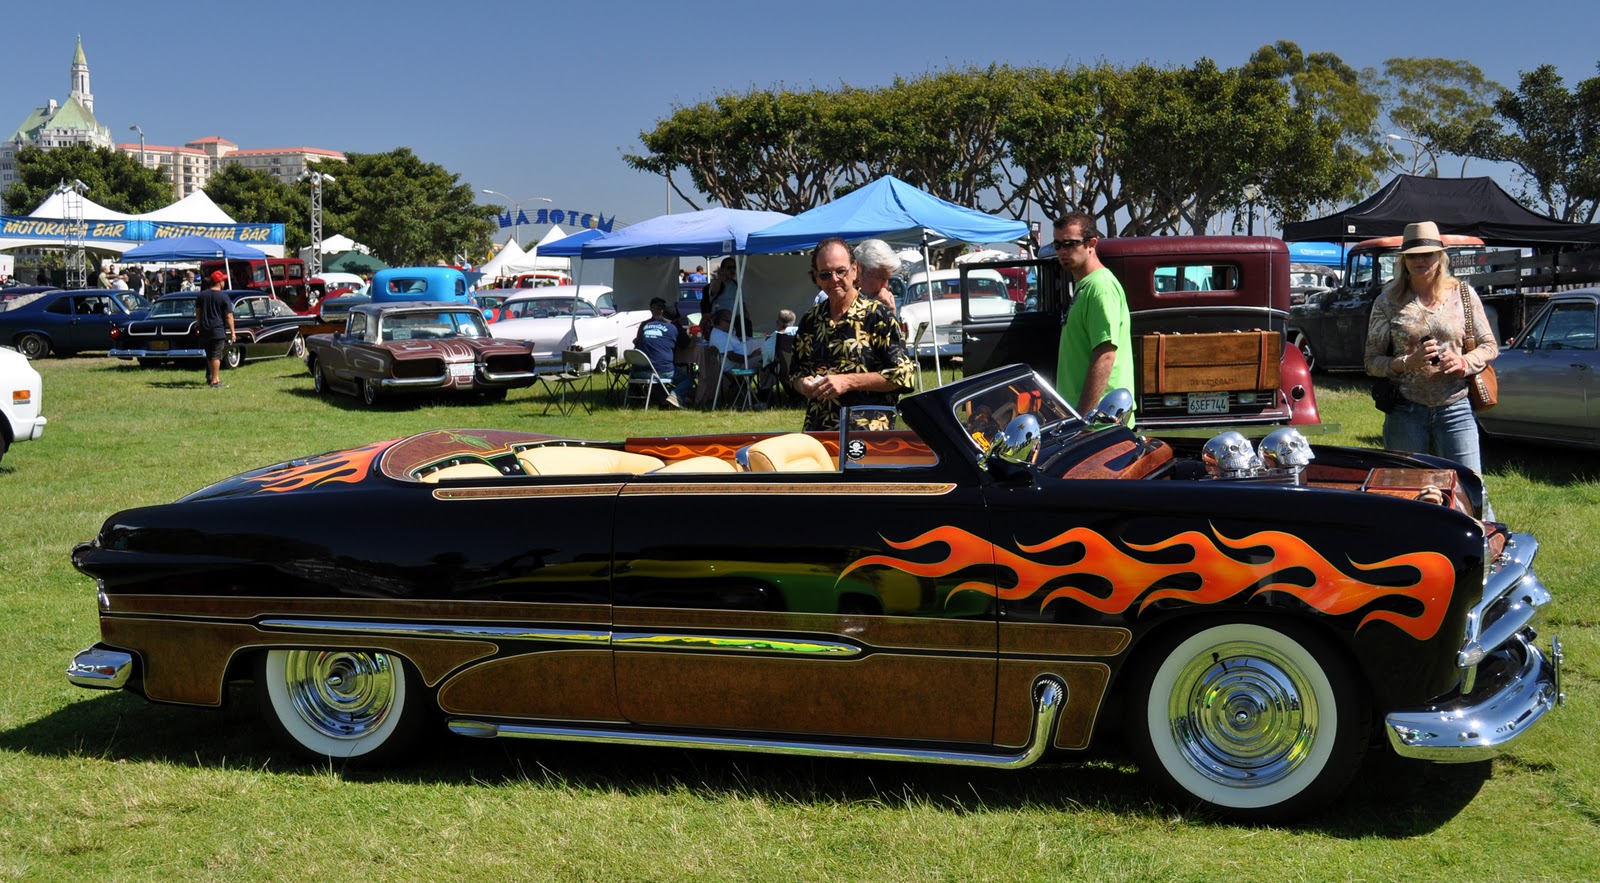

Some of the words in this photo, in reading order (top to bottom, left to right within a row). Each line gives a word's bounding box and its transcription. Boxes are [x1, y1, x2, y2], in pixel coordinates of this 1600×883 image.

[3, 220, 89, 236] MOTORAMA
[93, 223, 126, 238] BAR
[155, 225, 236, 240] MOTORAMA
[239, 227, 271, 241] BAR
[1451, 255, 1476, 267] GARAGE
[1190, 399, 1227, 412] 6SEF744
